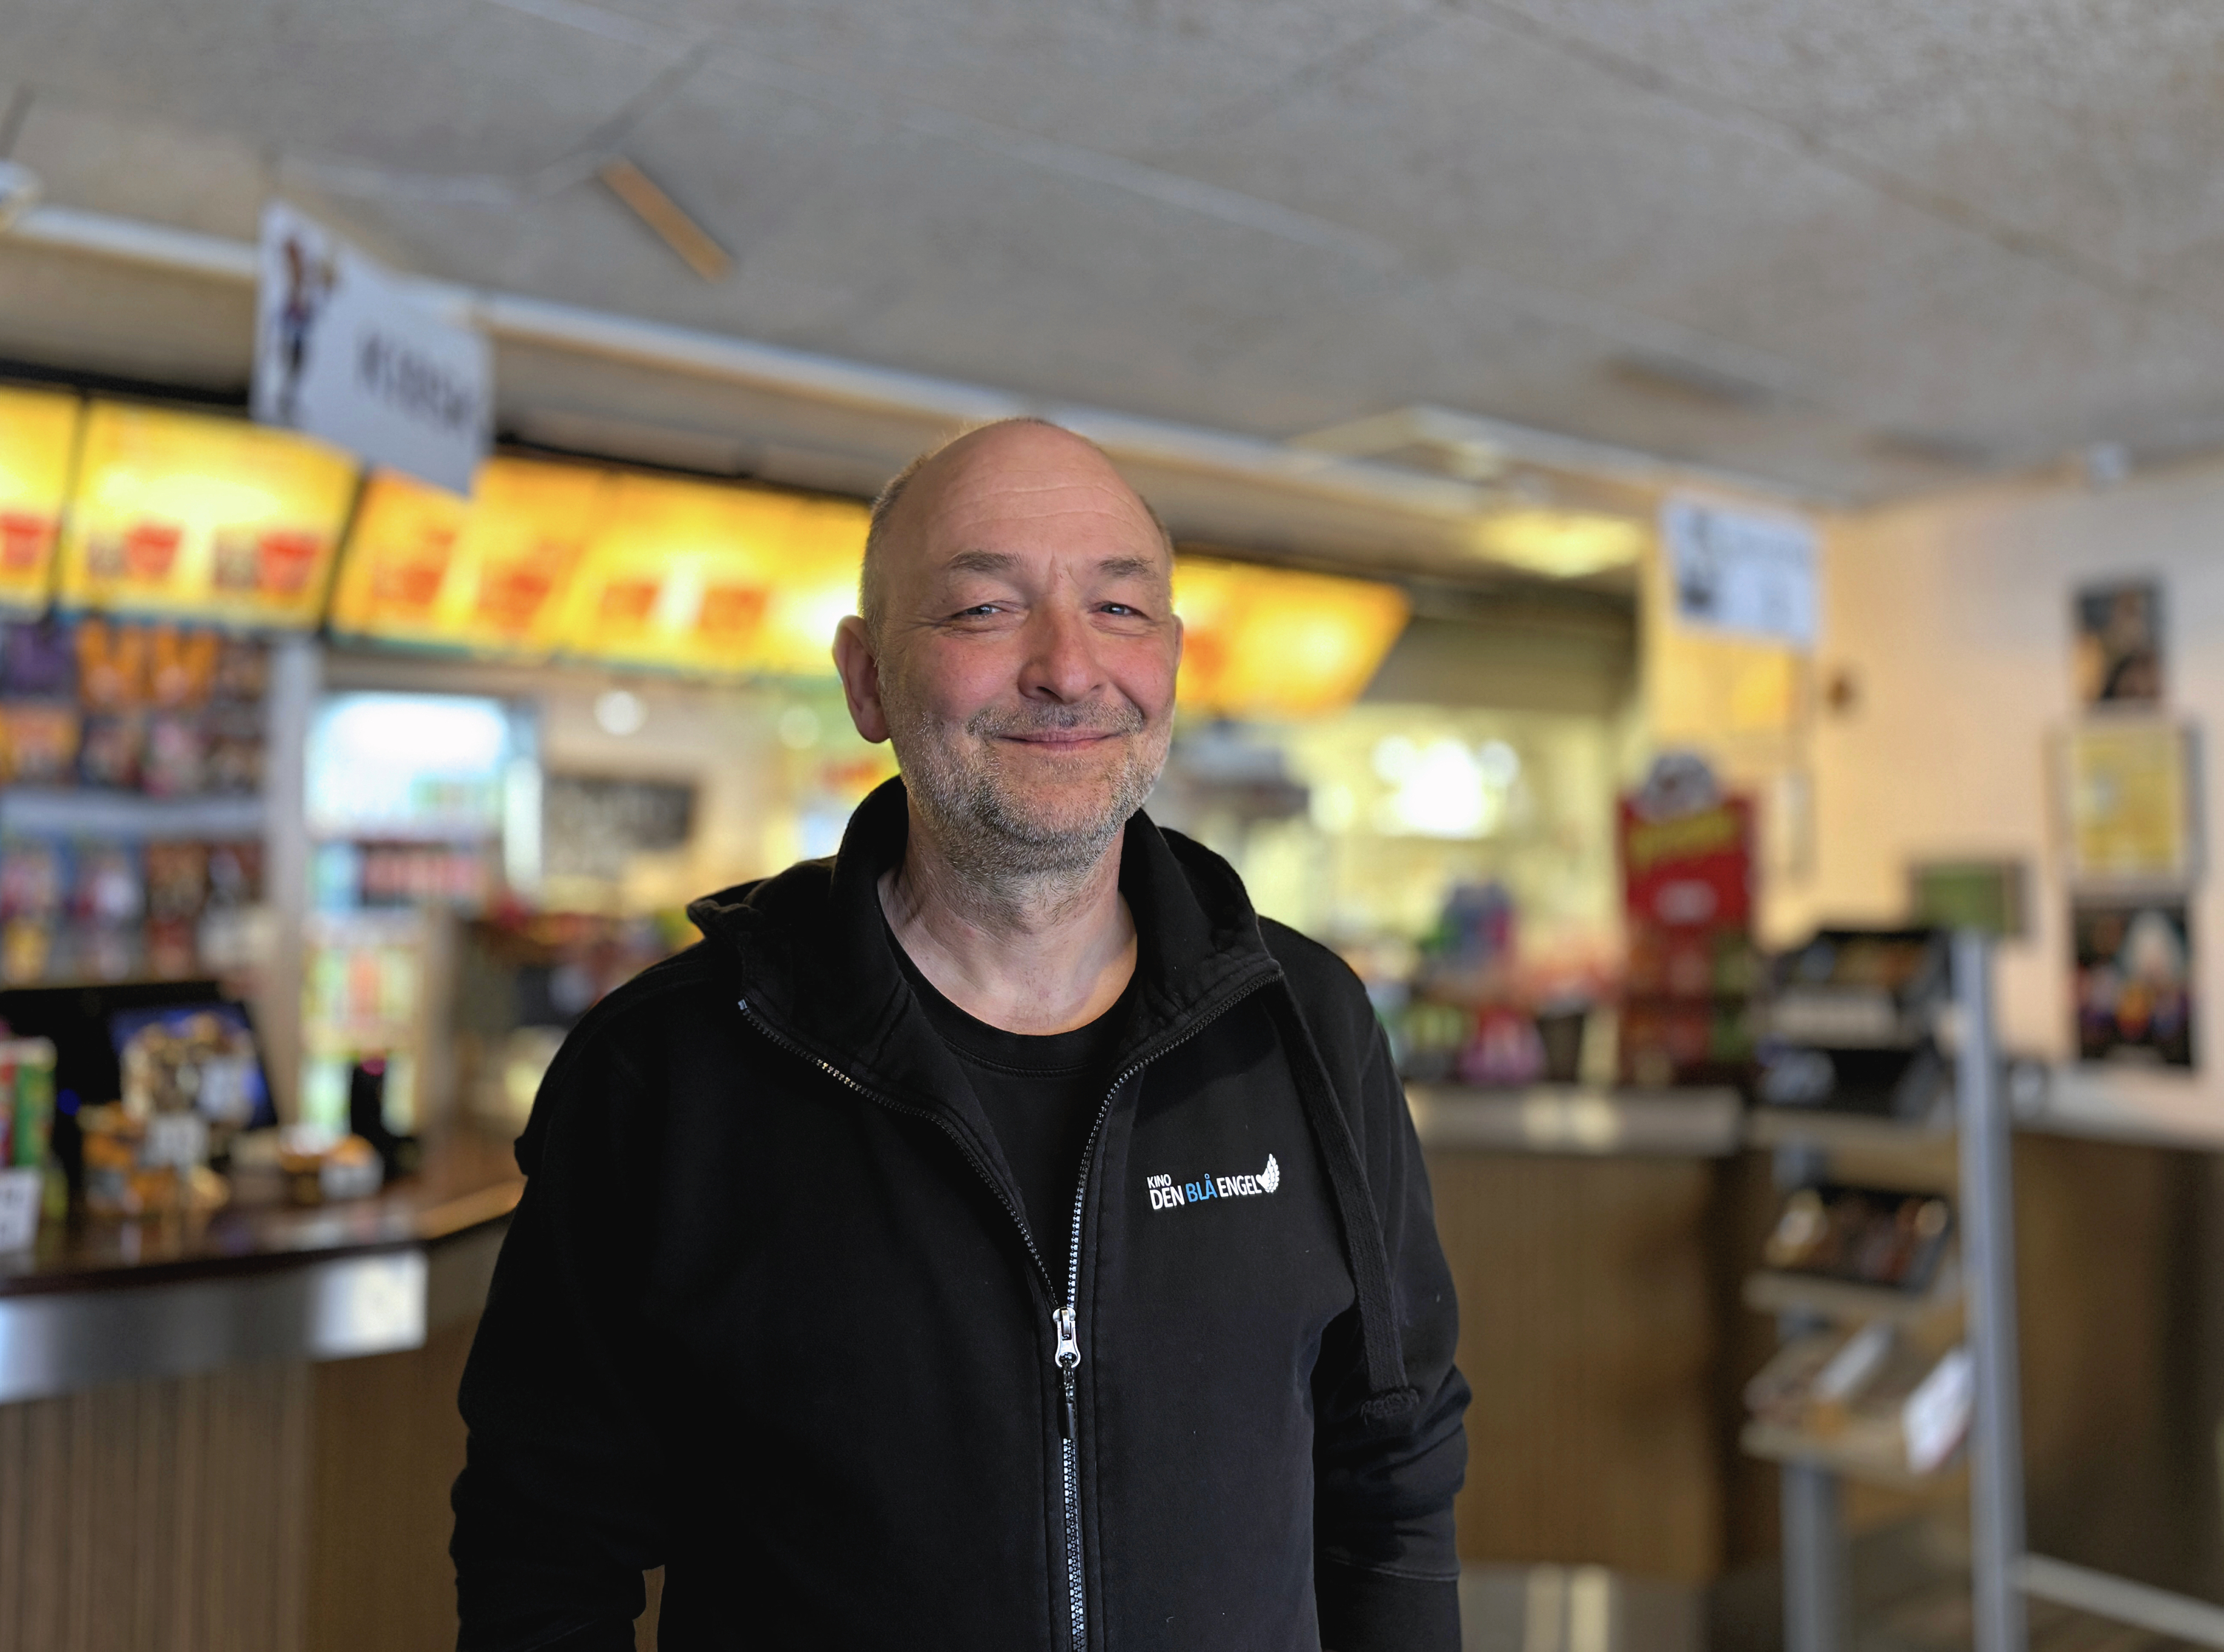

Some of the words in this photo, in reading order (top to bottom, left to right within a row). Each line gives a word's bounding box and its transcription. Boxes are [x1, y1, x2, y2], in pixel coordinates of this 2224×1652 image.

[1147, 1174, 1171, 1189] KINO
[1149, 1185, 1185, 1210] DEN
[1185, 1173, 1218, 1203] BLÅ
[1217, 1175, 1262, 1198] ENGEL
